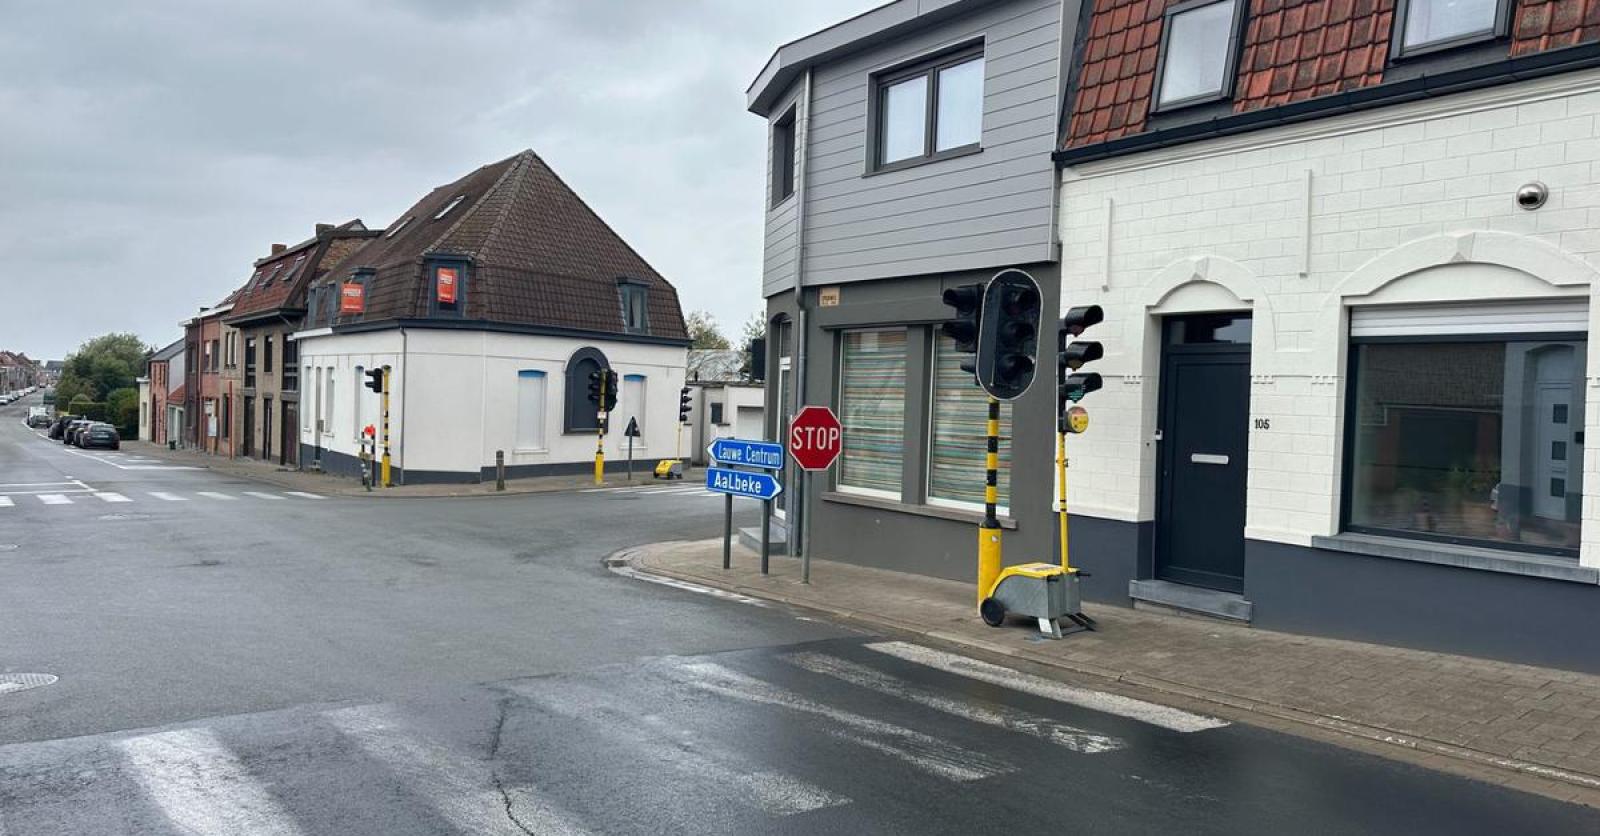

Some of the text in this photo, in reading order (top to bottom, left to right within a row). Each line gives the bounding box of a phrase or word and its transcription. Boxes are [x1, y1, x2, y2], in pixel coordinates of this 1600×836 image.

[792, 427, 839, 450] STOP
[719, 443, 780, 465] Lauwe Centrum
